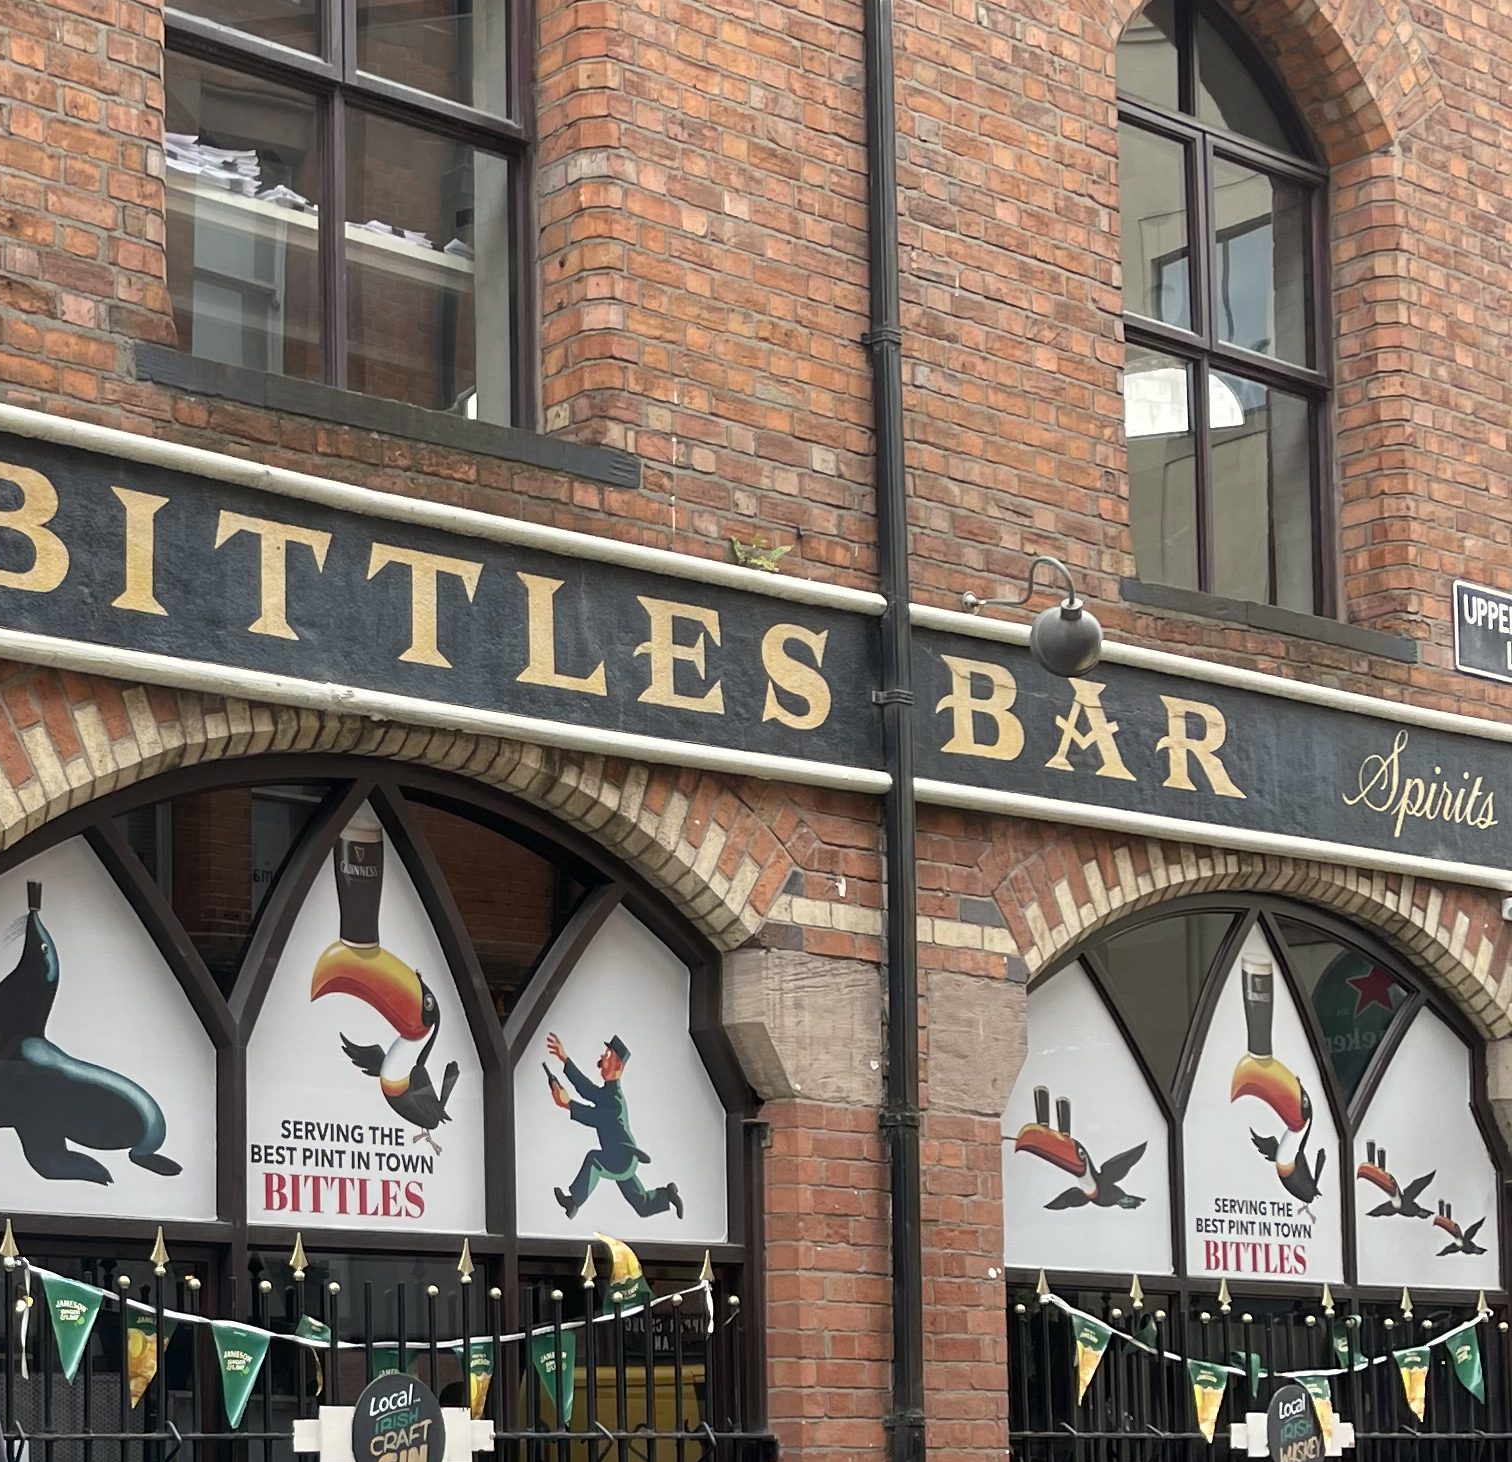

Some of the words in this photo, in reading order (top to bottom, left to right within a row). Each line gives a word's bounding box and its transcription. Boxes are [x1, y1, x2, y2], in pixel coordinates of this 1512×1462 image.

[1463, 593, 1512, 635] UPPE
[935, 654, 1247, 799] BAR
[1342, 729, 1498, 838] Spirits
[280, 1119, 364, 1144] SERVING
[369, 1126, 405, 1146] THE
[250, 1144, 297, 1165] BEST
[302, 1147, 346, 1169] PINT
[351, 1150, 370, 1170] IN
[375, 1152, 434, 1174] TOWN
[262, 1172, 425, 1219] BITTLES
[1214, 1198, 1267, 1216] SERVING
[1270, 1201, 1293, 1217] THE
[1195, 1218, 1225, 1234] BEST
[1228, 1219, 1256, 1236] PINT
[1259, 1222, 1272, 1237] IN
[1274, 1222, 1312, 1239] TOWN
[1203, 1239, 1307, 1275] BITTLES
[375, 1407, 419, 1435] IRISH
[1278, 1392, 1306, 1420] Local
[370, 1418, 433, 1457] CRAFT
